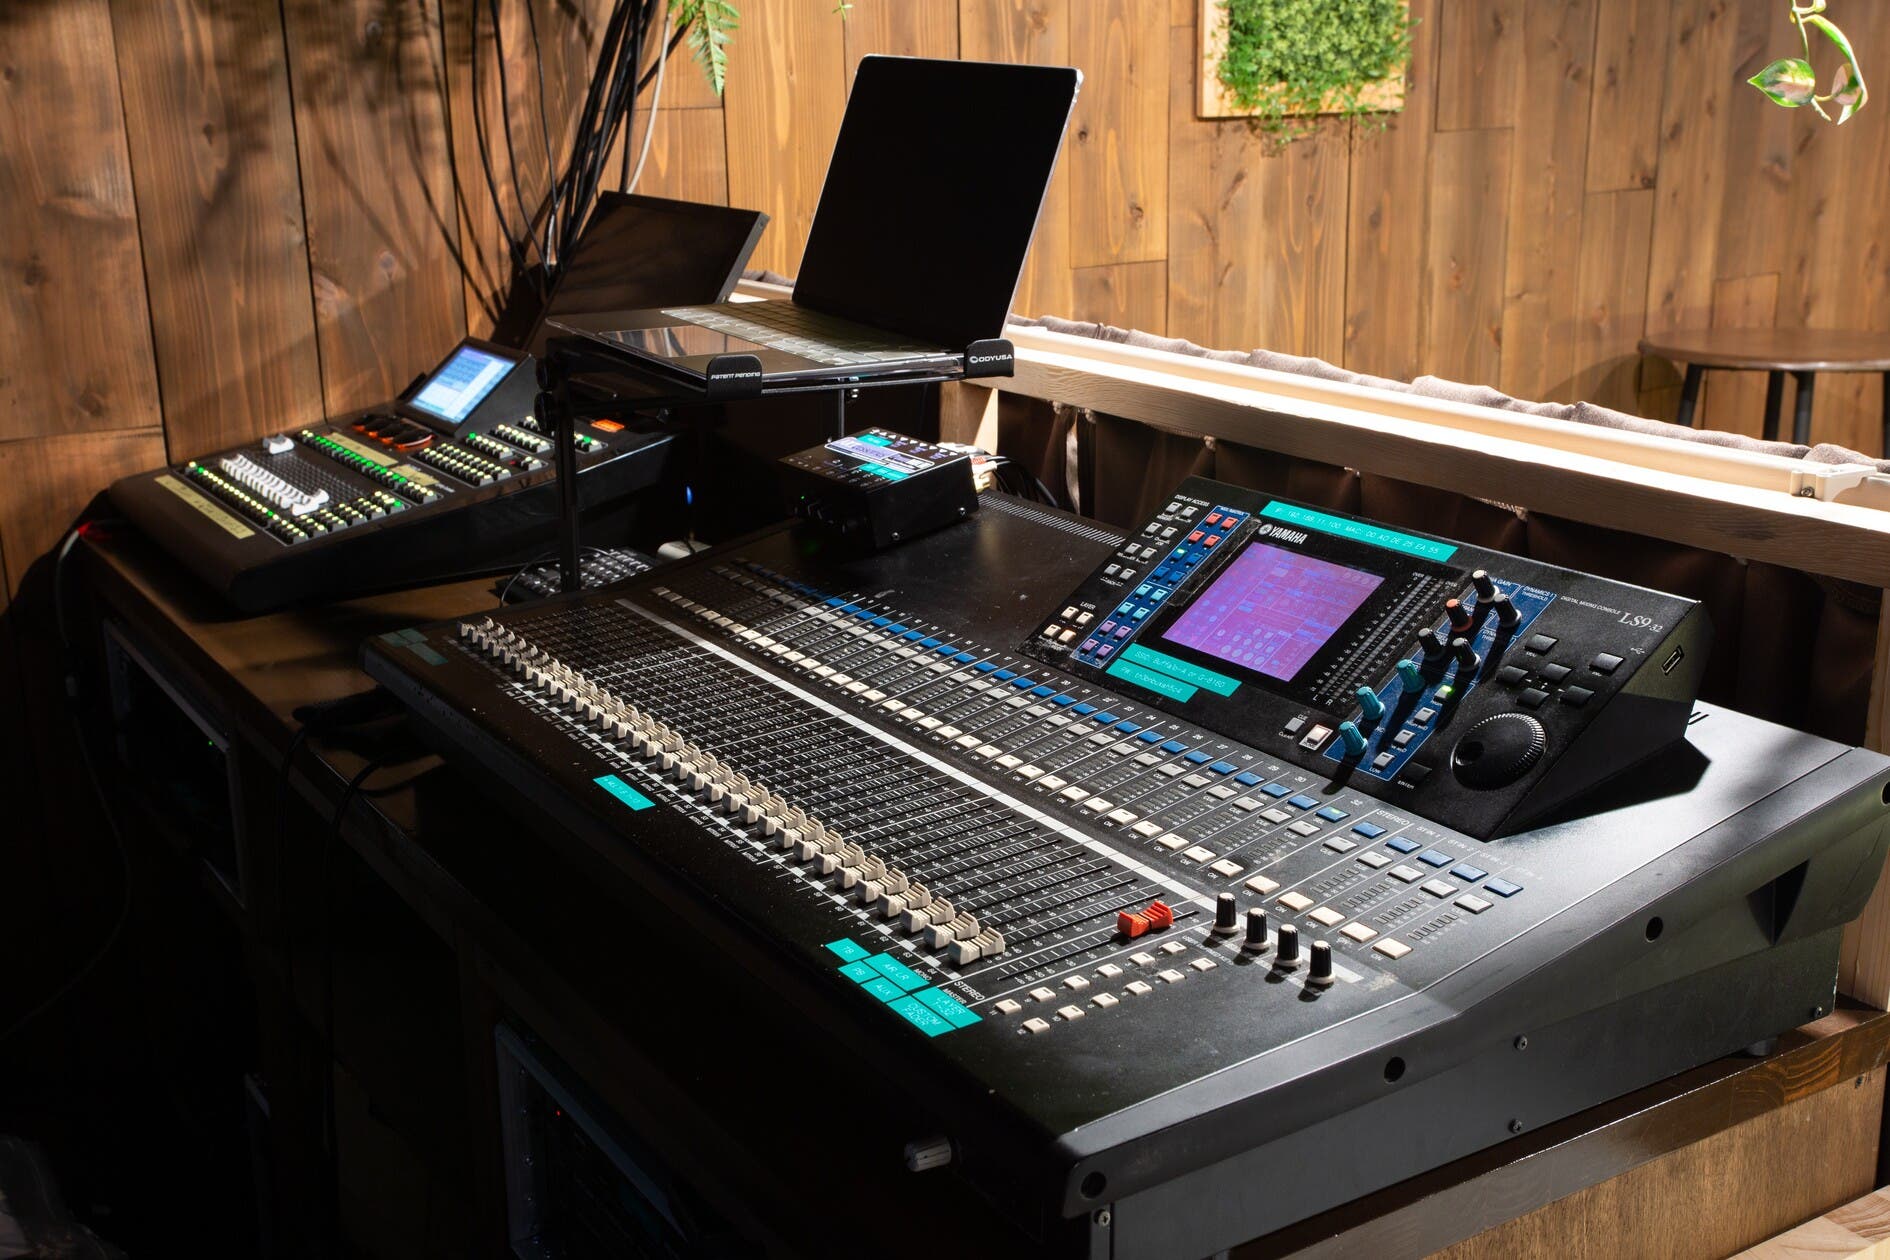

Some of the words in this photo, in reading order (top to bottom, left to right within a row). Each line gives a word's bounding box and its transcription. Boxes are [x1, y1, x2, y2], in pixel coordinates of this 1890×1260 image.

[1269, 526, 1308, 544] YAMAHA
[1345, 526, 1364, 534] MAC:
[1523, 586, 1550, 597] DYNAMICS
[1080, 601, 1096, 610] LAYER
[1560, 596, 1579, 604] DIGITAL
[1580, 600, 1598, 610] MIXING
[1597, 604, 1621, 614] CONSOLE
[1376, 810, 1410, 826] STEREO
[875, 984, 892, 996] AUX
[942, 988, 968, 1004] MASTER
[953, 980, 986, 1000] STEREO
[908, 1003, 941, 1026] CUSTOM
[936, 998, 966, 1015] LAYER
[904, 1008, 930, 1026] FADER
